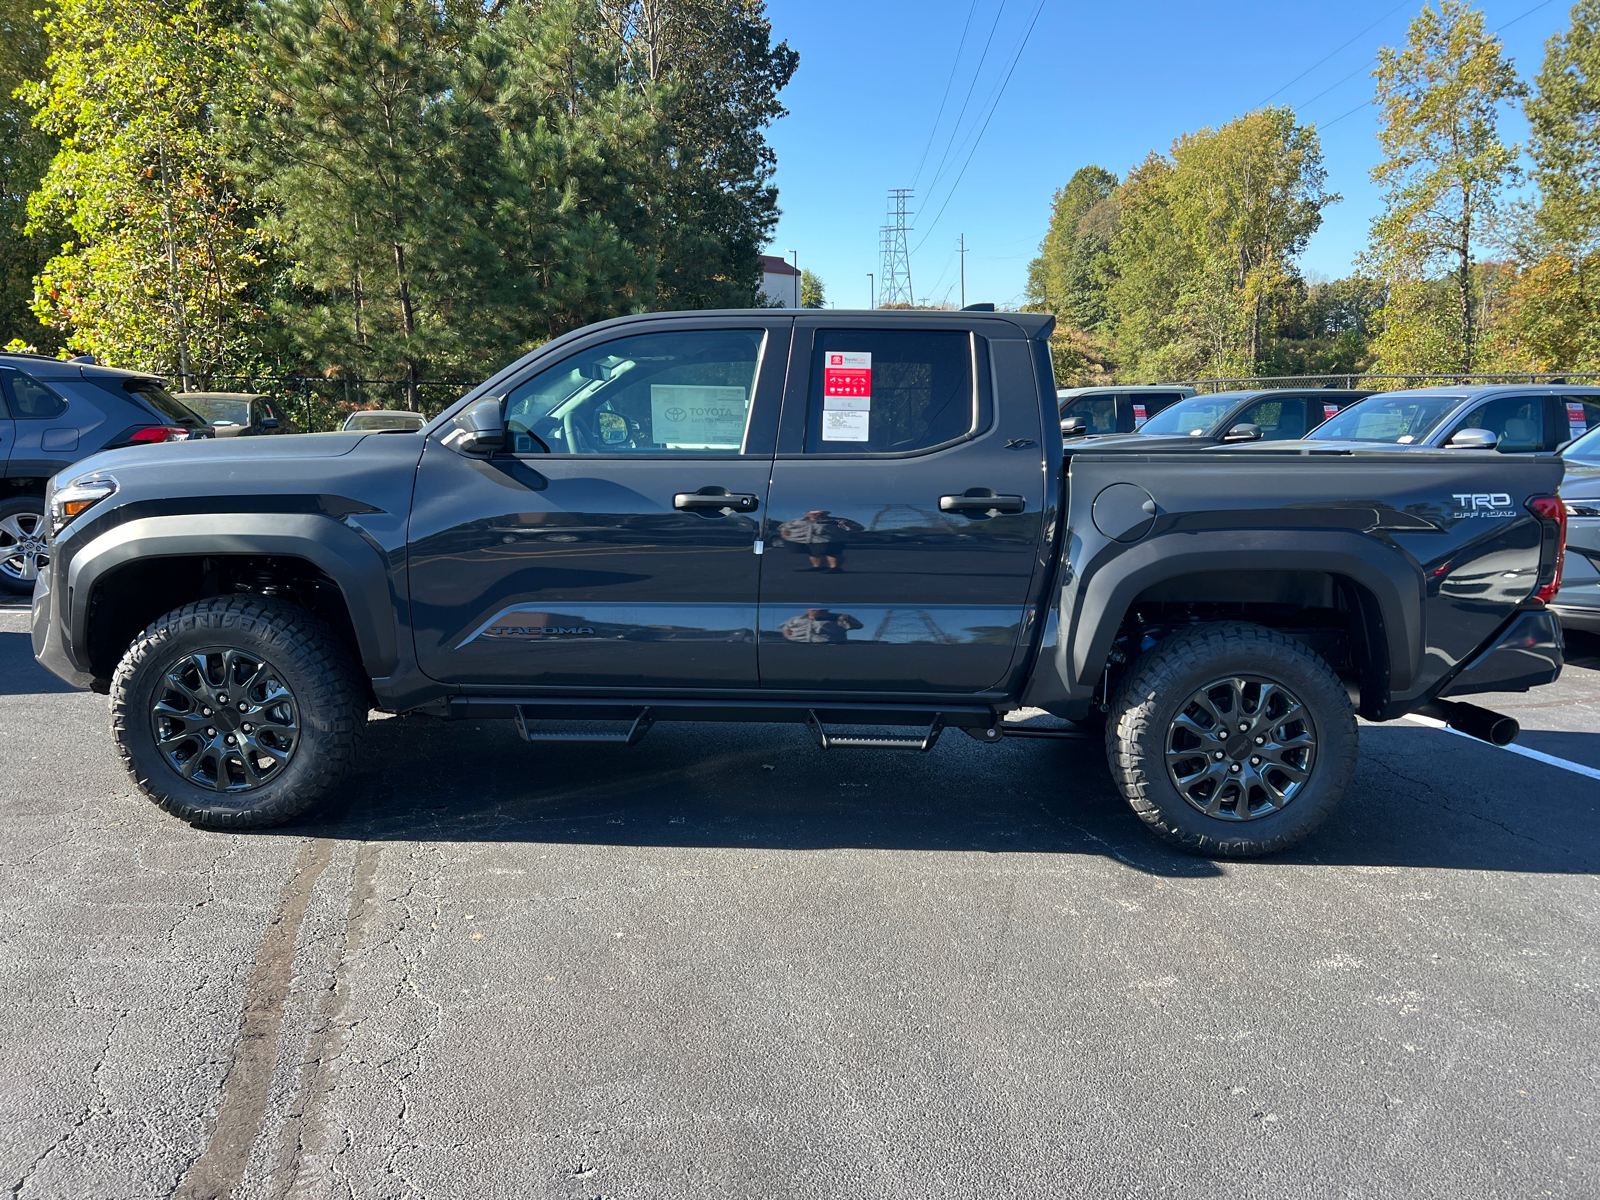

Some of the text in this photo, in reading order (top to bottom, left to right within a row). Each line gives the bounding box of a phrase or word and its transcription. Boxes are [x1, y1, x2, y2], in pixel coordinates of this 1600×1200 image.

[689, 407, 733, 417] TOYOTA
[1451, 492, 1512, 510] TRD
[1453, 510, 1517, 519] OFF ROAD
[490, 626, 595, 635] TACOMA
